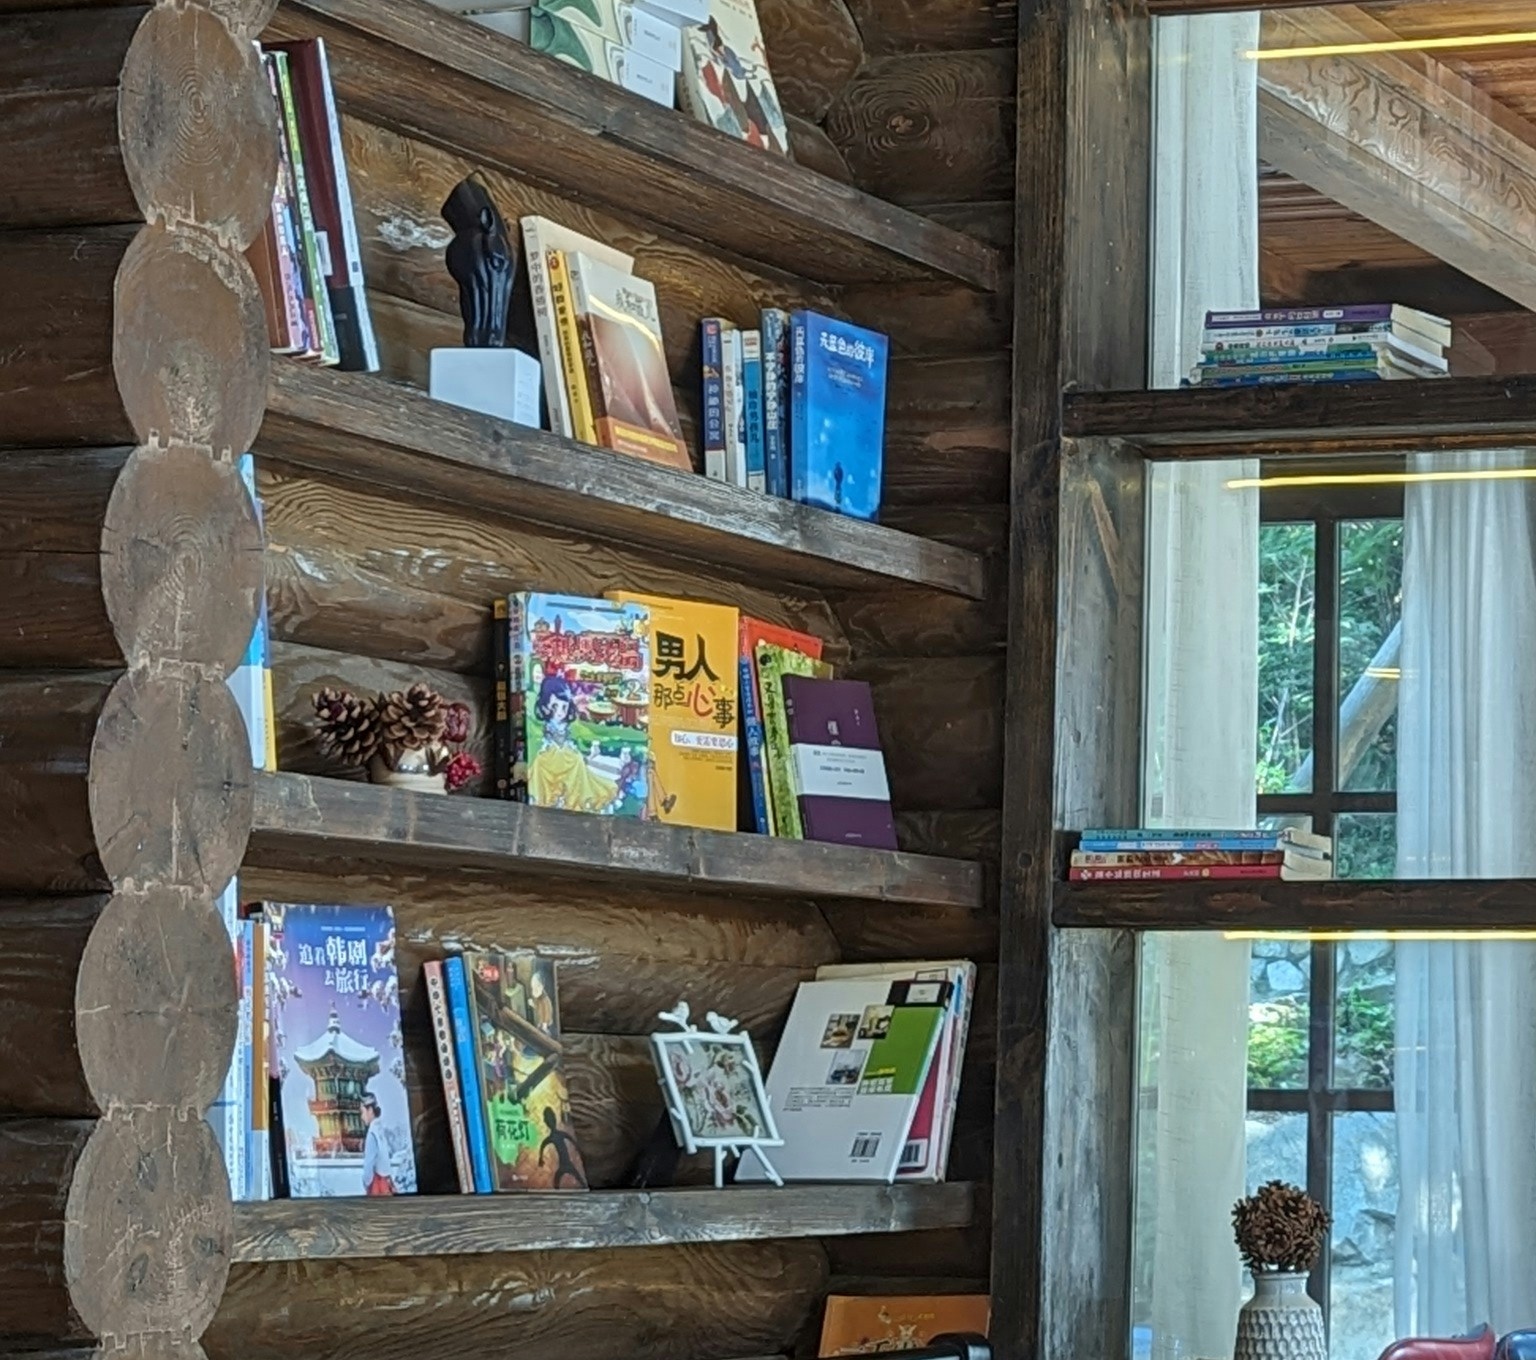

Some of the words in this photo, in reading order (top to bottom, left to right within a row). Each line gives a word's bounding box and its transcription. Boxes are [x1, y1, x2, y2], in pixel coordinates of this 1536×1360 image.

[819, 331, 876, 370] 天蓝色的彼岸
[652, 630, 721, 682] 男人
[654, 682, 736, 729] 那点心事
[298, 935, 368, 967] 追着韩剧
[324, 967, 370, 994] 去旅行
